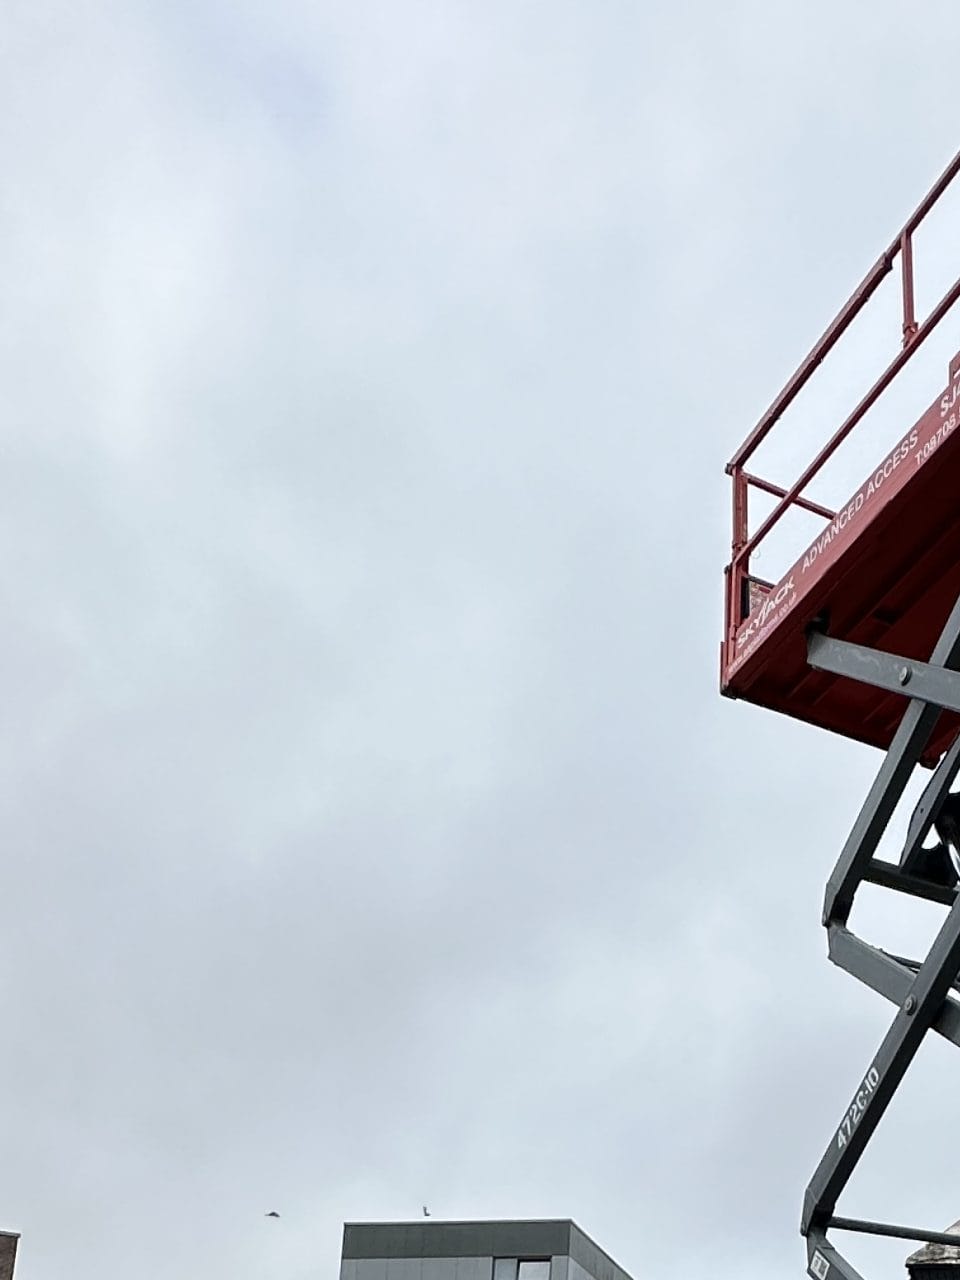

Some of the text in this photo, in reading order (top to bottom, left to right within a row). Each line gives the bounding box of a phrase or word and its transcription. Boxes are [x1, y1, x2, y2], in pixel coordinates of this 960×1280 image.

[801, 430, 919, 573] ADVANCED ACCESS
[737, 575, 795, 649] SKYJACK
